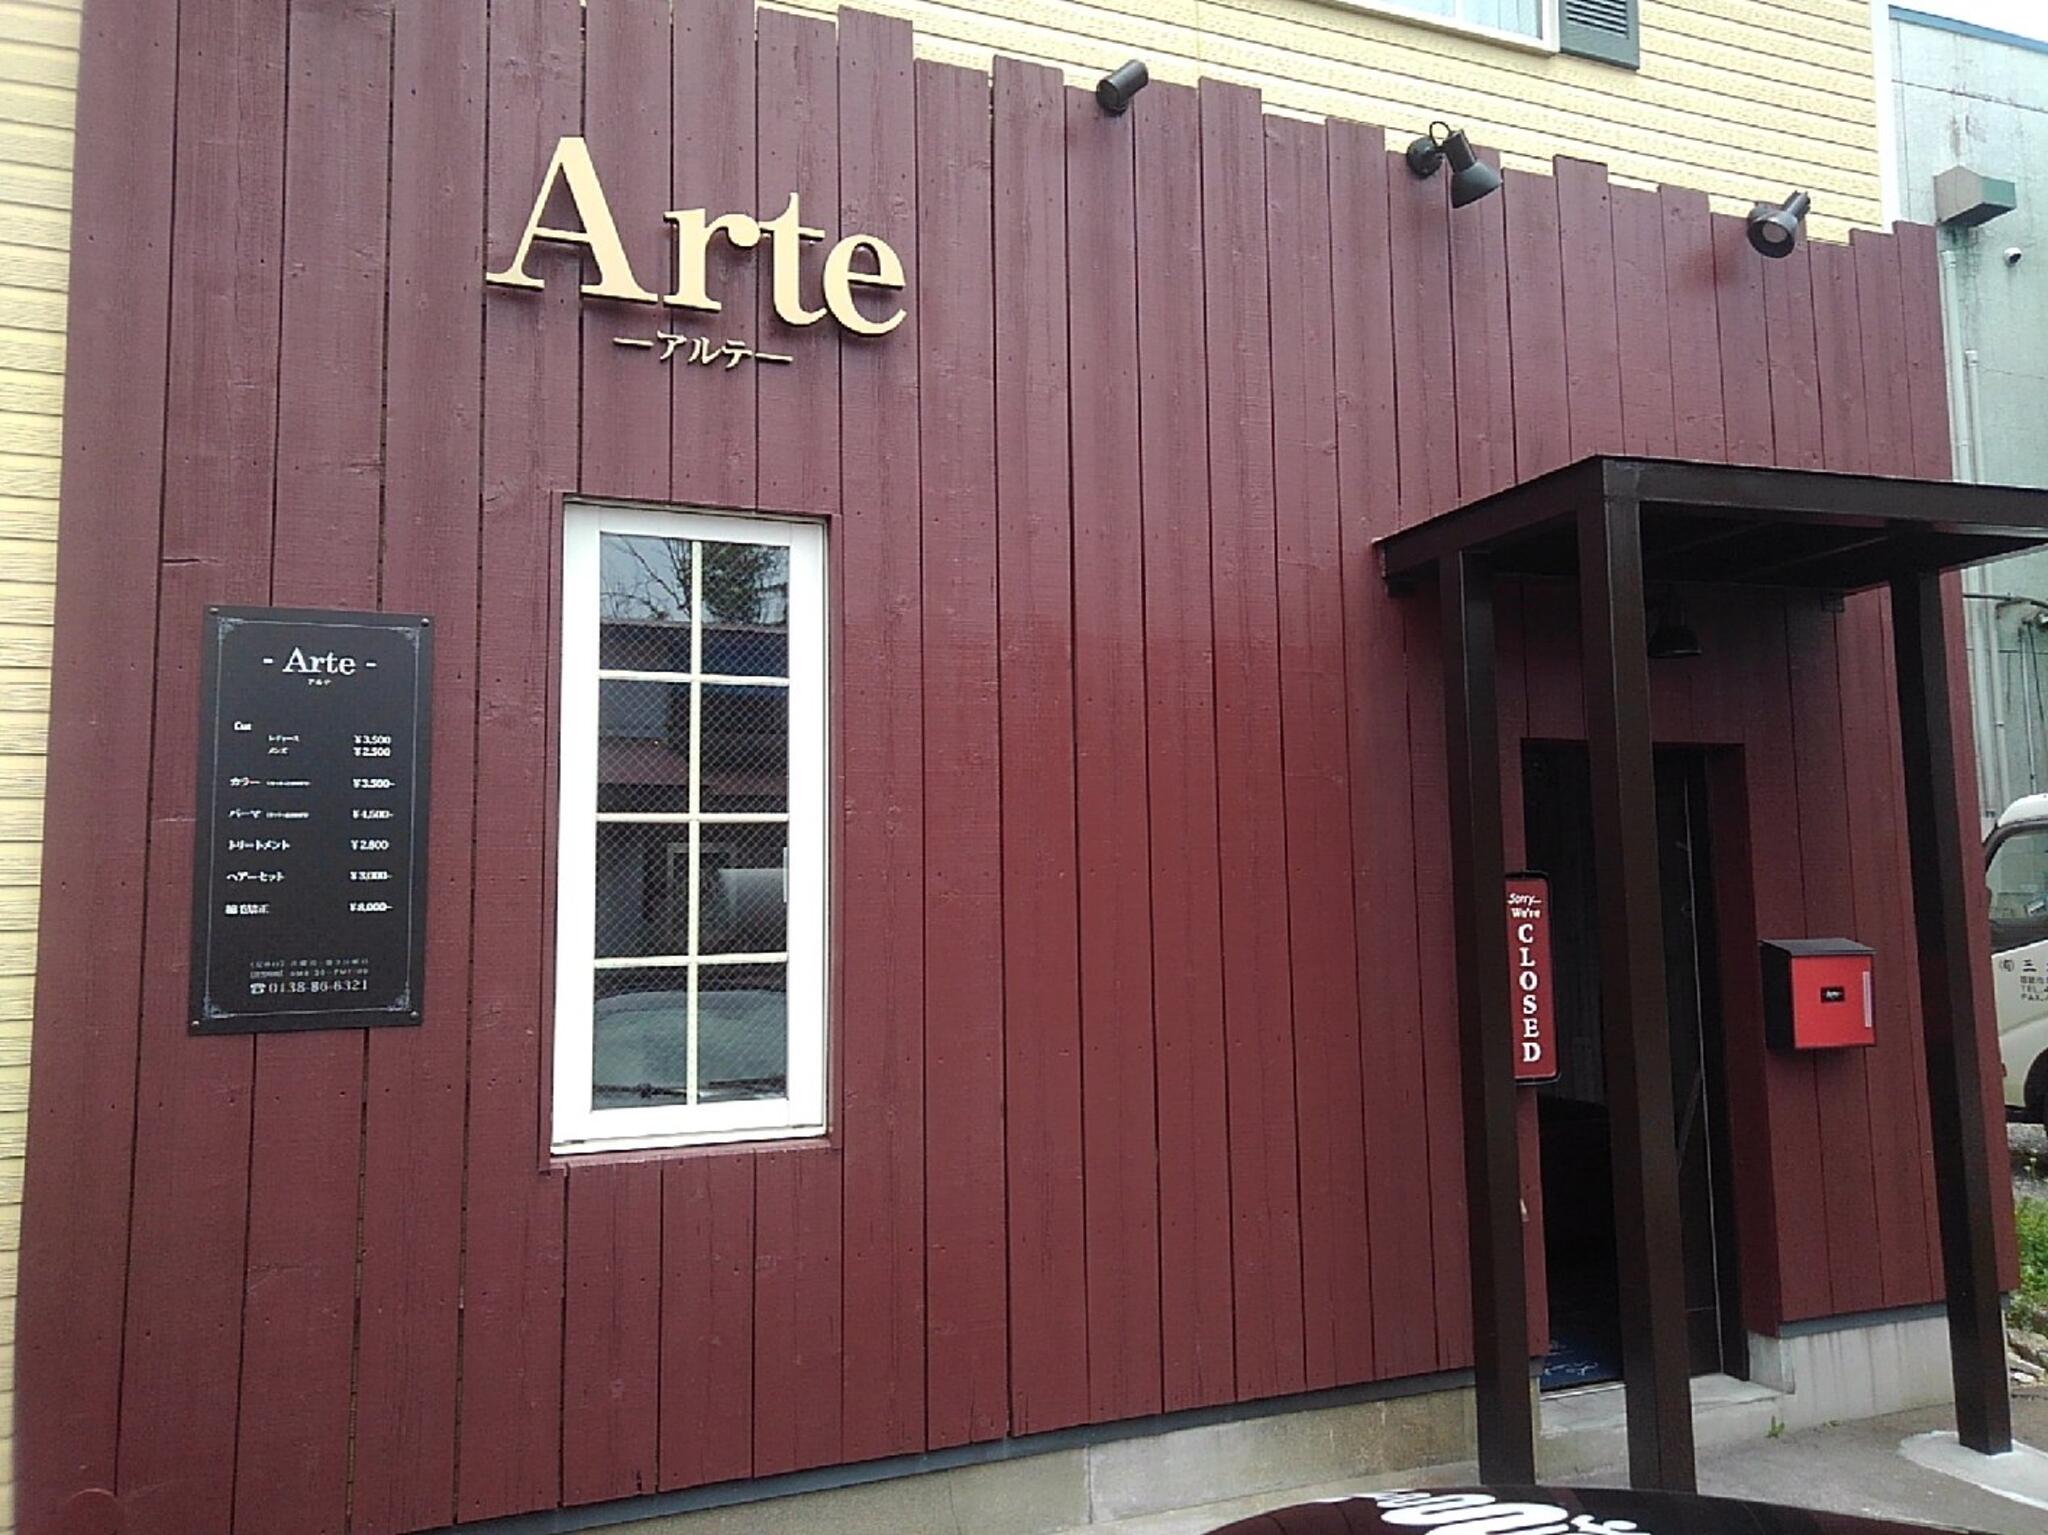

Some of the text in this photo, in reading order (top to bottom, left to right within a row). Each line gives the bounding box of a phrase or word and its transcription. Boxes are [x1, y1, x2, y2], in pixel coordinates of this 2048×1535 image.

[486, 135, 908, 337] Arte
[282, 646, 357, 676] Arte
[228, 839, 291, 851] トリートメント
[1517, 923, 1542, 1063] CLOSED
